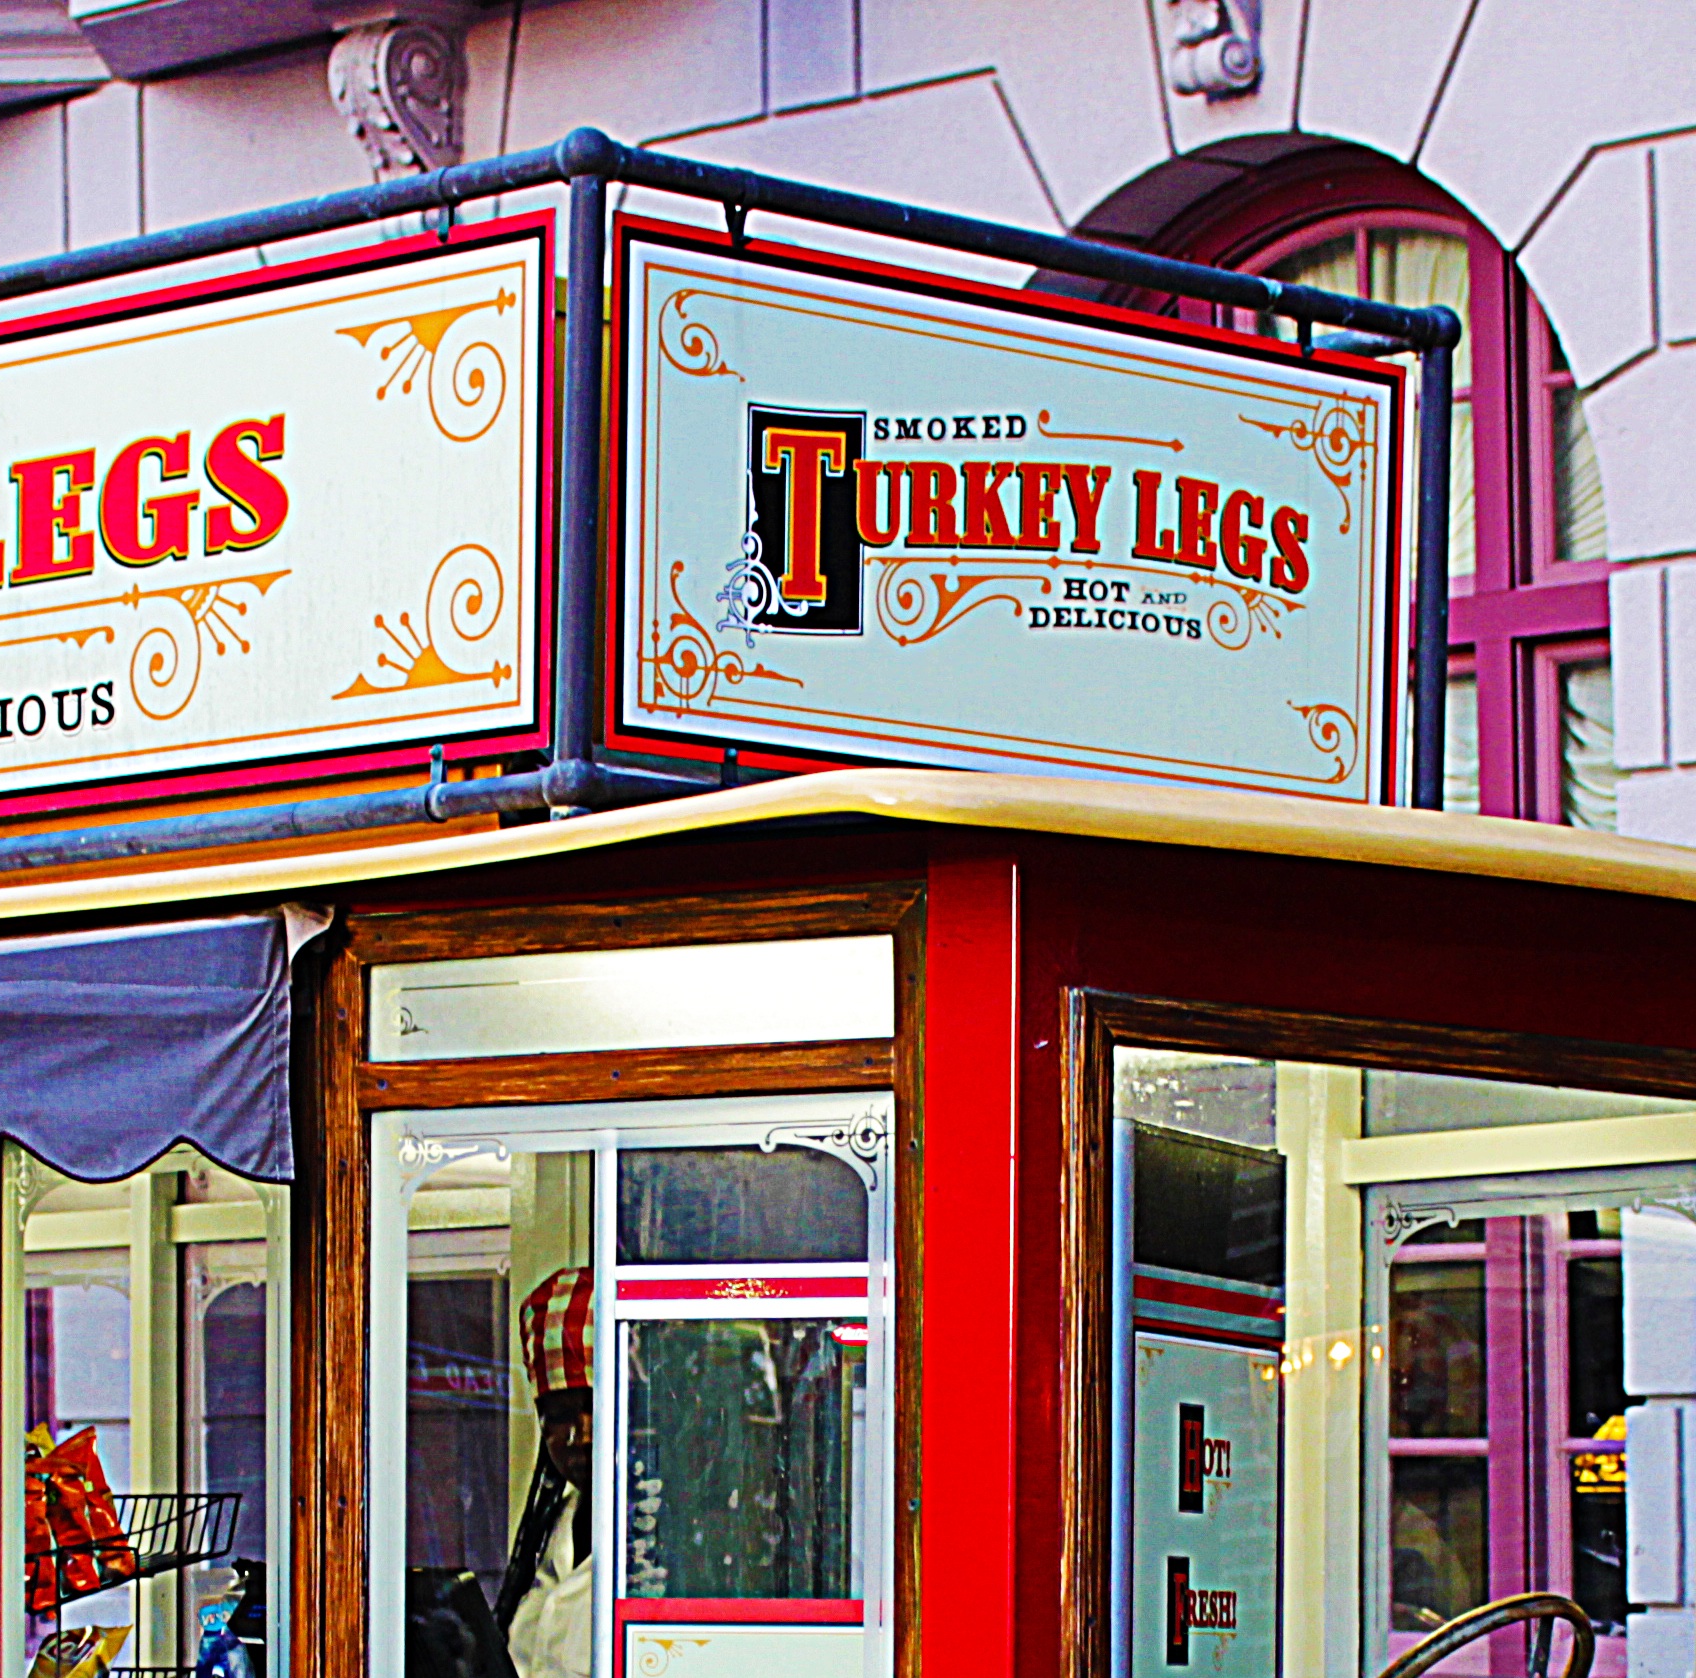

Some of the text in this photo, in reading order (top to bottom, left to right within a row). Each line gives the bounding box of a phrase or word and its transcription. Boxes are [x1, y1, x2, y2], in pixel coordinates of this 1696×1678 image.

[874, 414, 1029, 441] SMOKED
[760, 427, 1310, 605] TURKEY LEGS
[1063, 579, 1188, 606] HOT AND
[1028, 606, 1203, 641] DELICIOUS
[1183, 1420, 1231, 1492] HOT!
